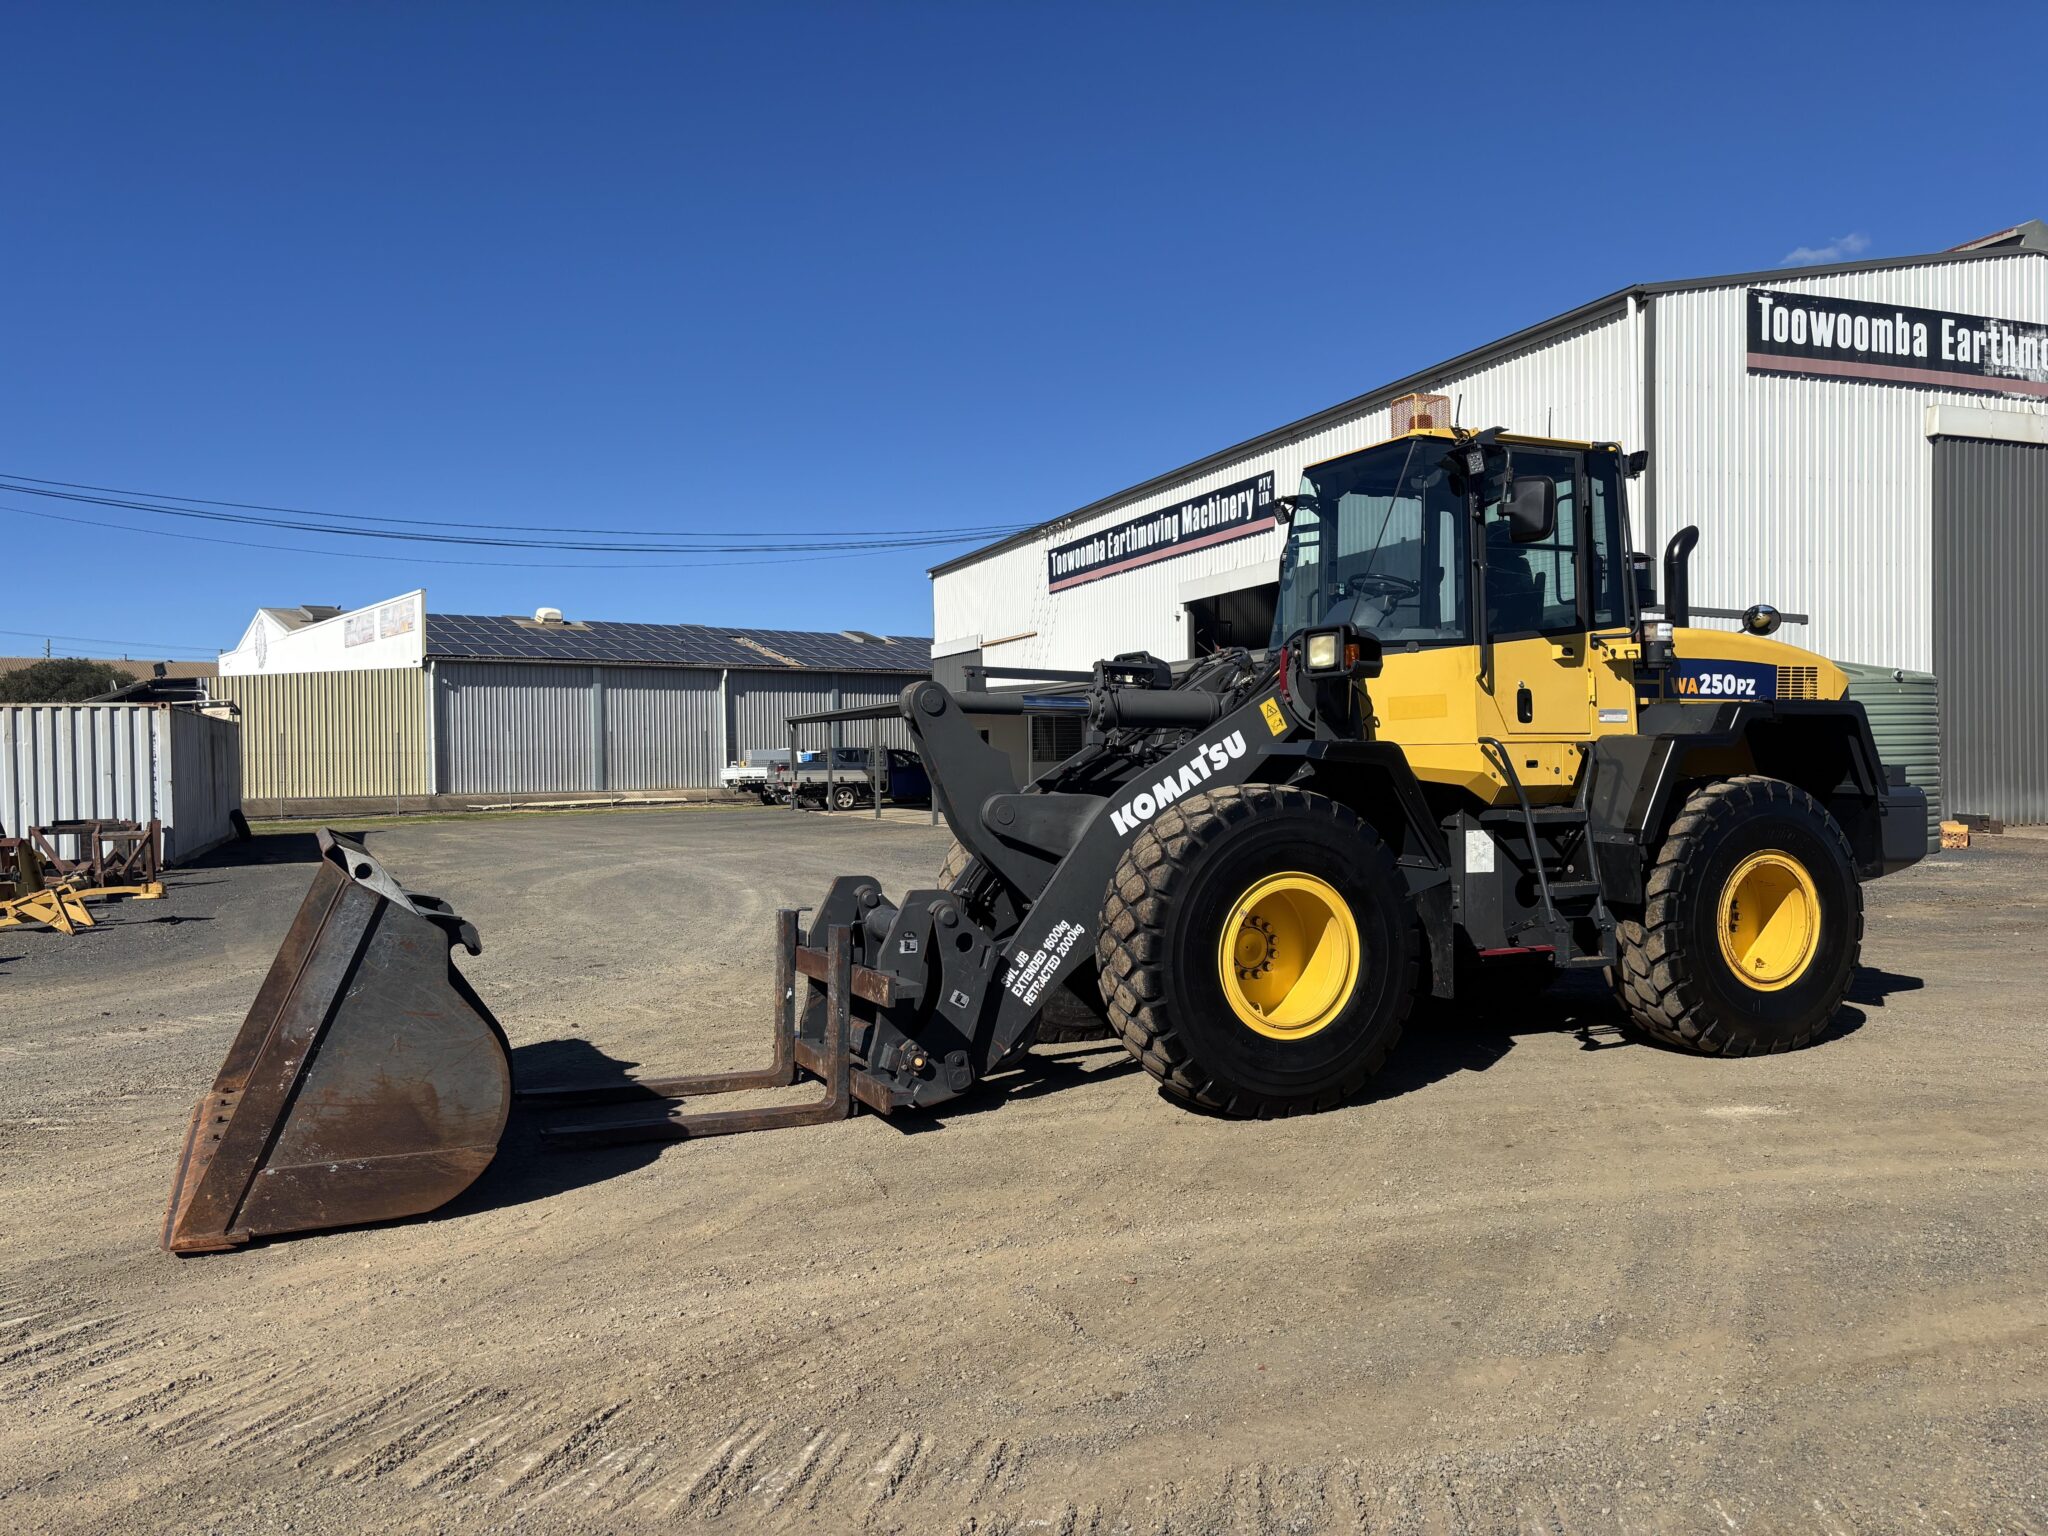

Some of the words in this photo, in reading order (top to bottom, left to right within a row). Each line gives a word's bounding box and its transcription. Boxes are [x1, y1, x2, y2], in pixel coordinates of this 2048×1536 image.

[1758, 296, 1928, 358] Toowoomba
[1258, 475, 1272, 492] PTY.
[1258, 492, 1272, 506] LTD.
[1051, 539, 1106, 577] Toowoomba
[1107, 514, 1179, 558] Earthmoving
[1182, 487, 1254, 536] Machinery
[1109, 729, 1247, 836] KOMATSU
[1001, 967, 1020, 988] SWL
[1015, 950, 1030, 968] JIB
[1011, 949, 1048, 998] EXTENDED
[1043, 919, 1071, 951] 1600kg
[1022, 954, 1061, 1007] RETRACTED
[1056, 923, 1085, 957] 2000kg
